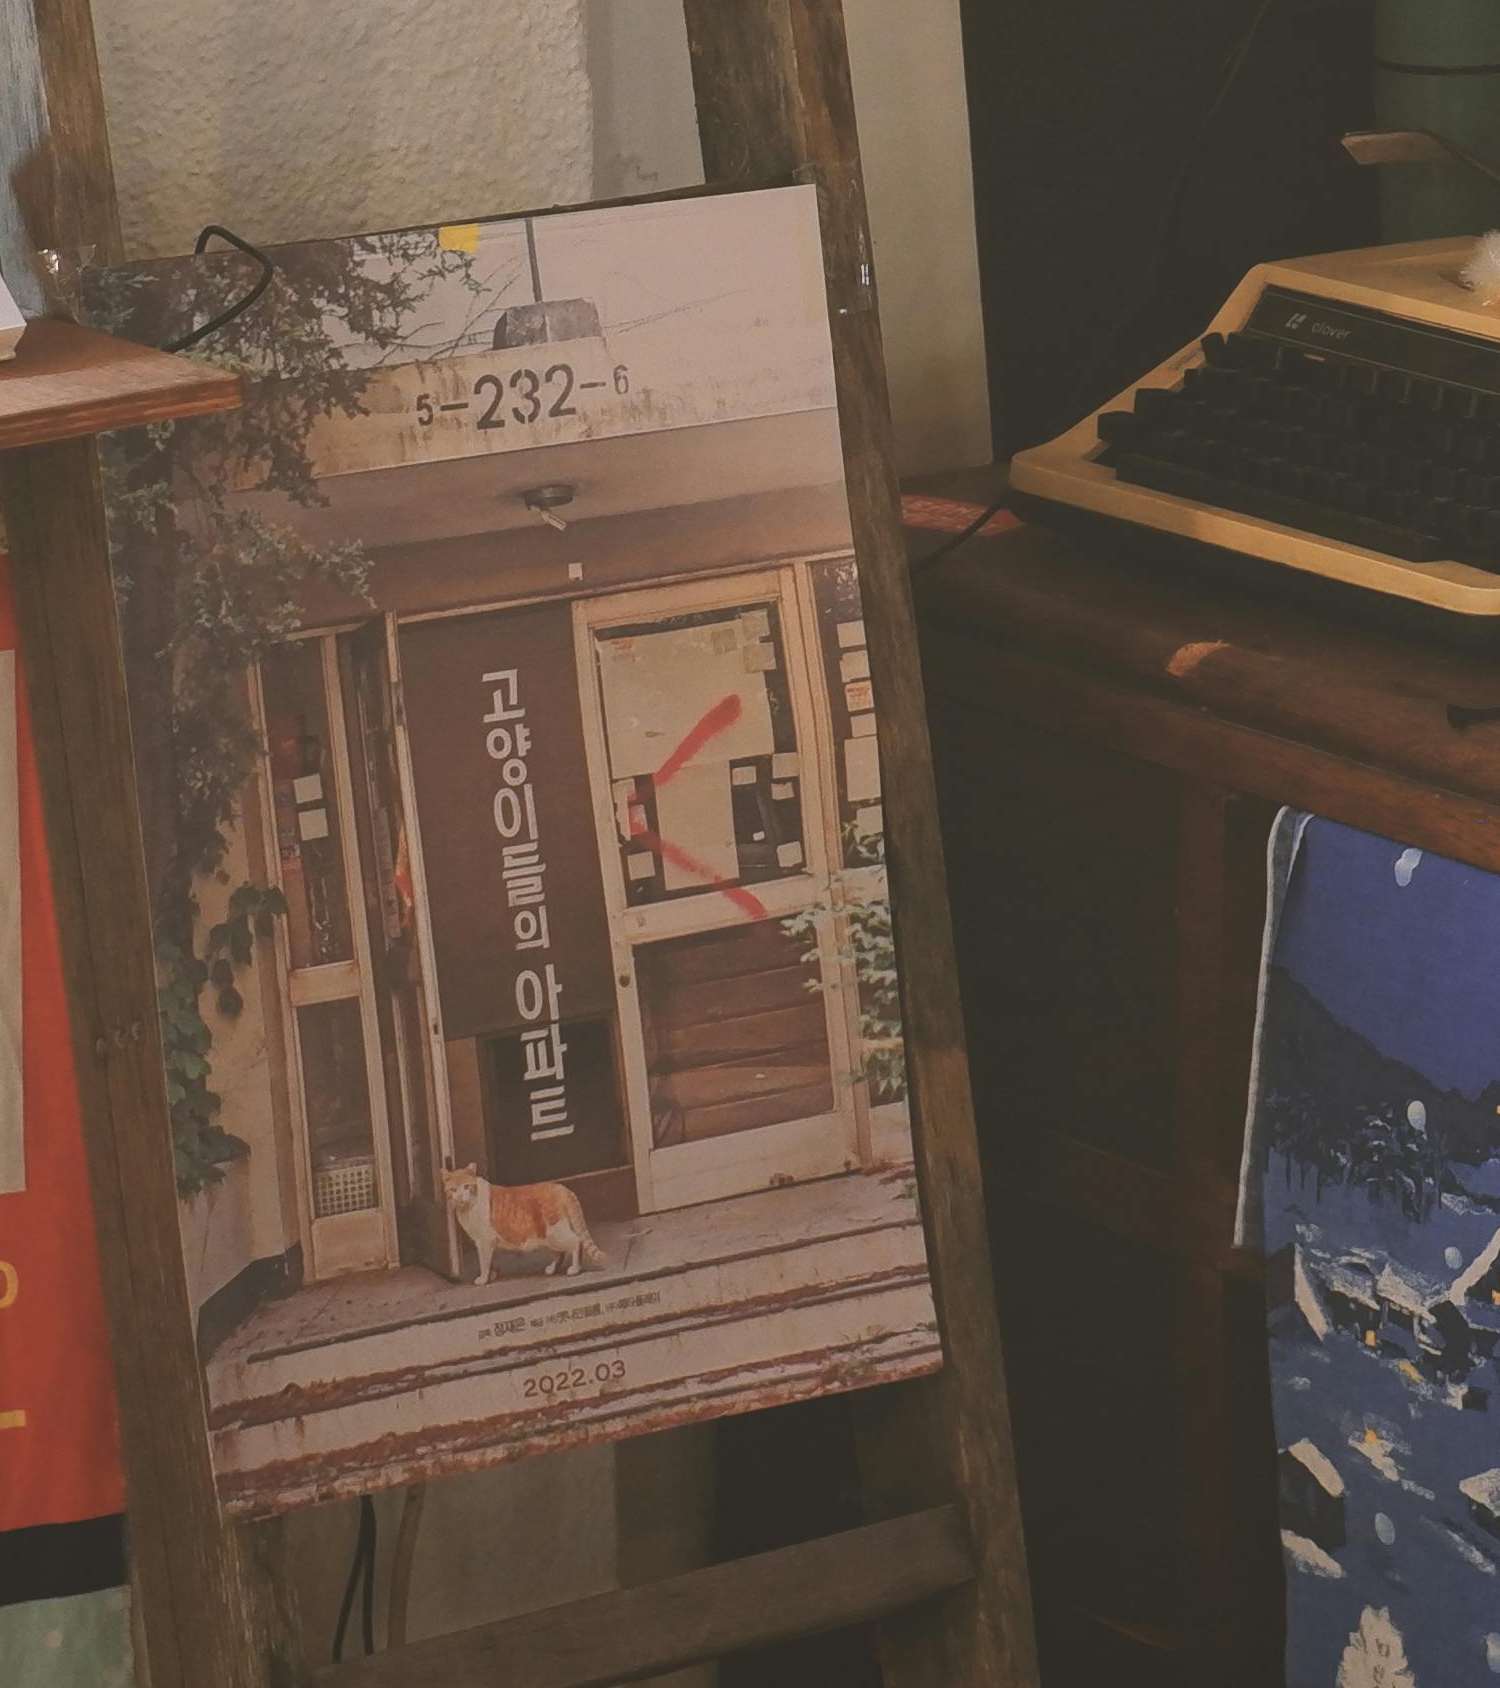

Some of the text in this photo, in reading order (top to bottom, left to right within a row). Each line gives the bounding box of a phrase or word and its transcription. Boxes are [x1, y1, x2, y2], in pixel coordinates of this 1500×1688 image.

[481, 667, 576, 1141] 고양이들의 아파트
[522, 1360, 627, 1400] 2022.03
